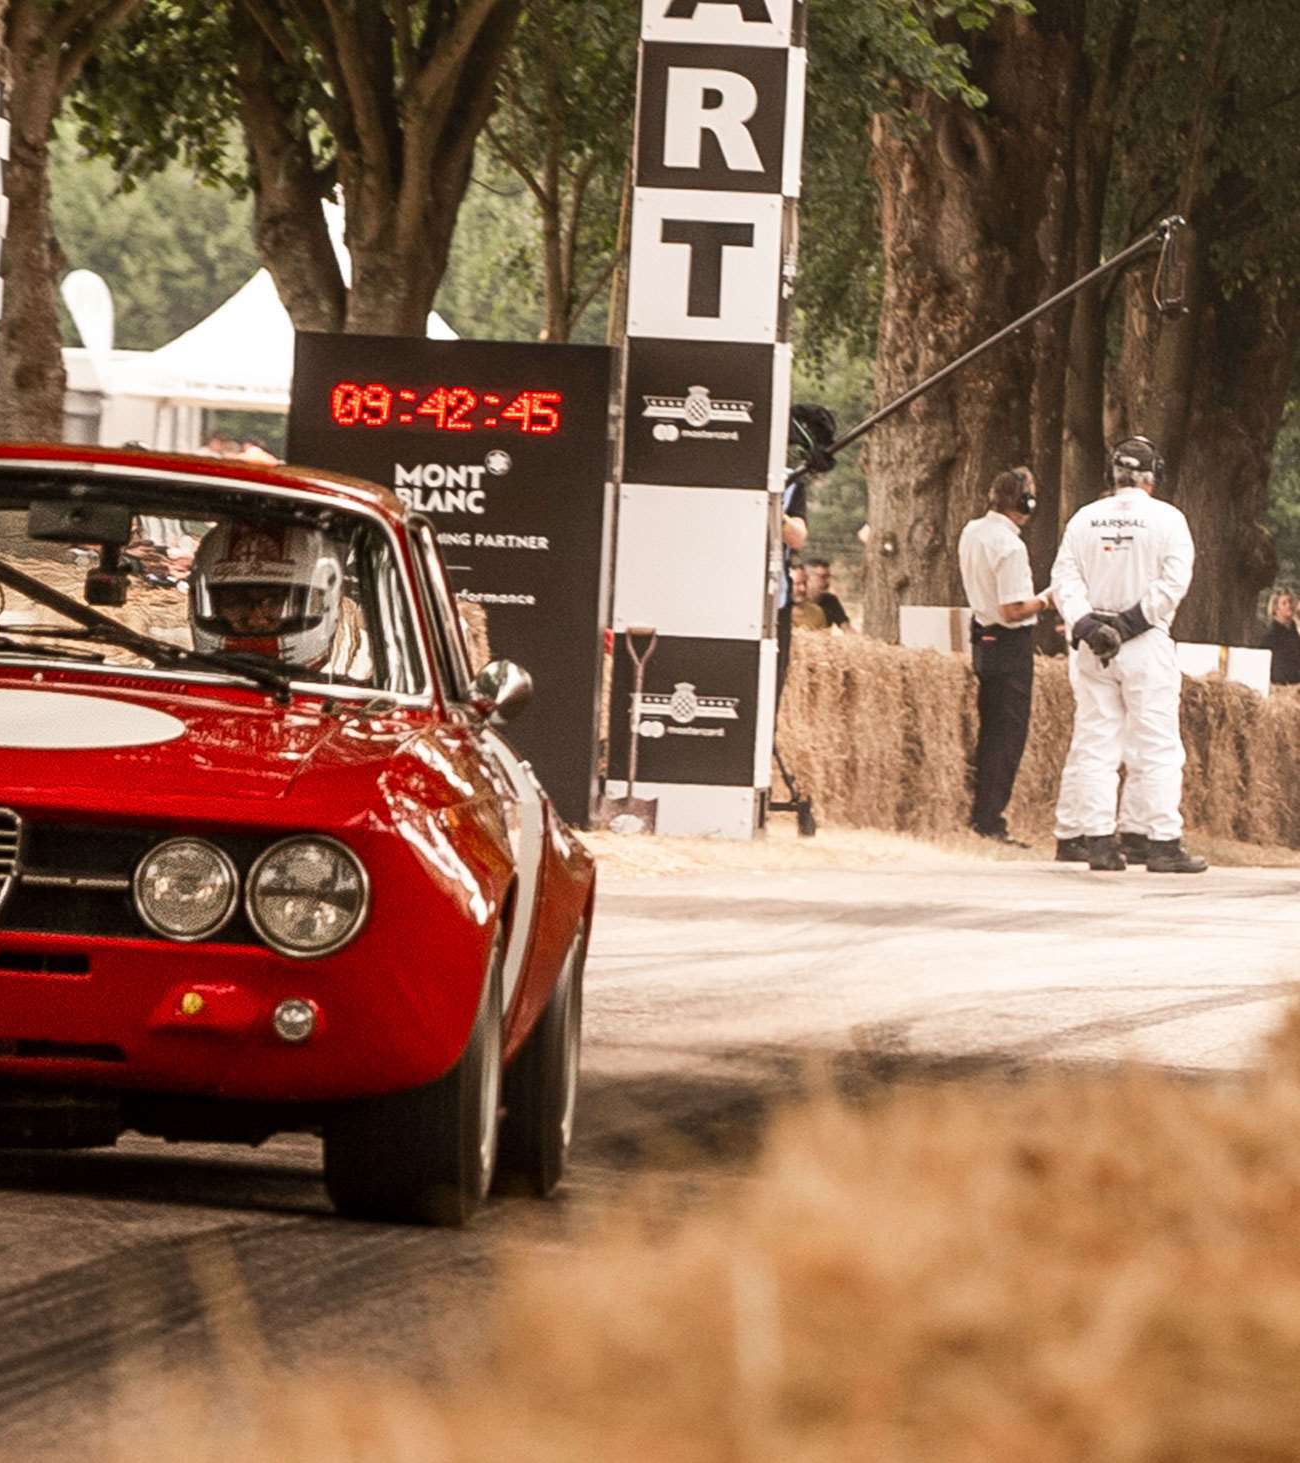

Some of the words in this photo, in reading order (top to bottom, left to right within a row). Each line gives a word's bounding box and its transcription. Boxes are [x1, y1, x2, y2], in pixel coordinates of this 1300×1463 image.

[660, 0, 773, 319] RT
[331, 381, 562, 434] 09:42:45
[395, 463, 486, 489] MONT
[394, 487, 485, 514] BLANC
[1091, 519, 1148, 529] MARSHAL
[475, 532, 549, 550] PARTNER
[453, 588, 536, 605] rformance
